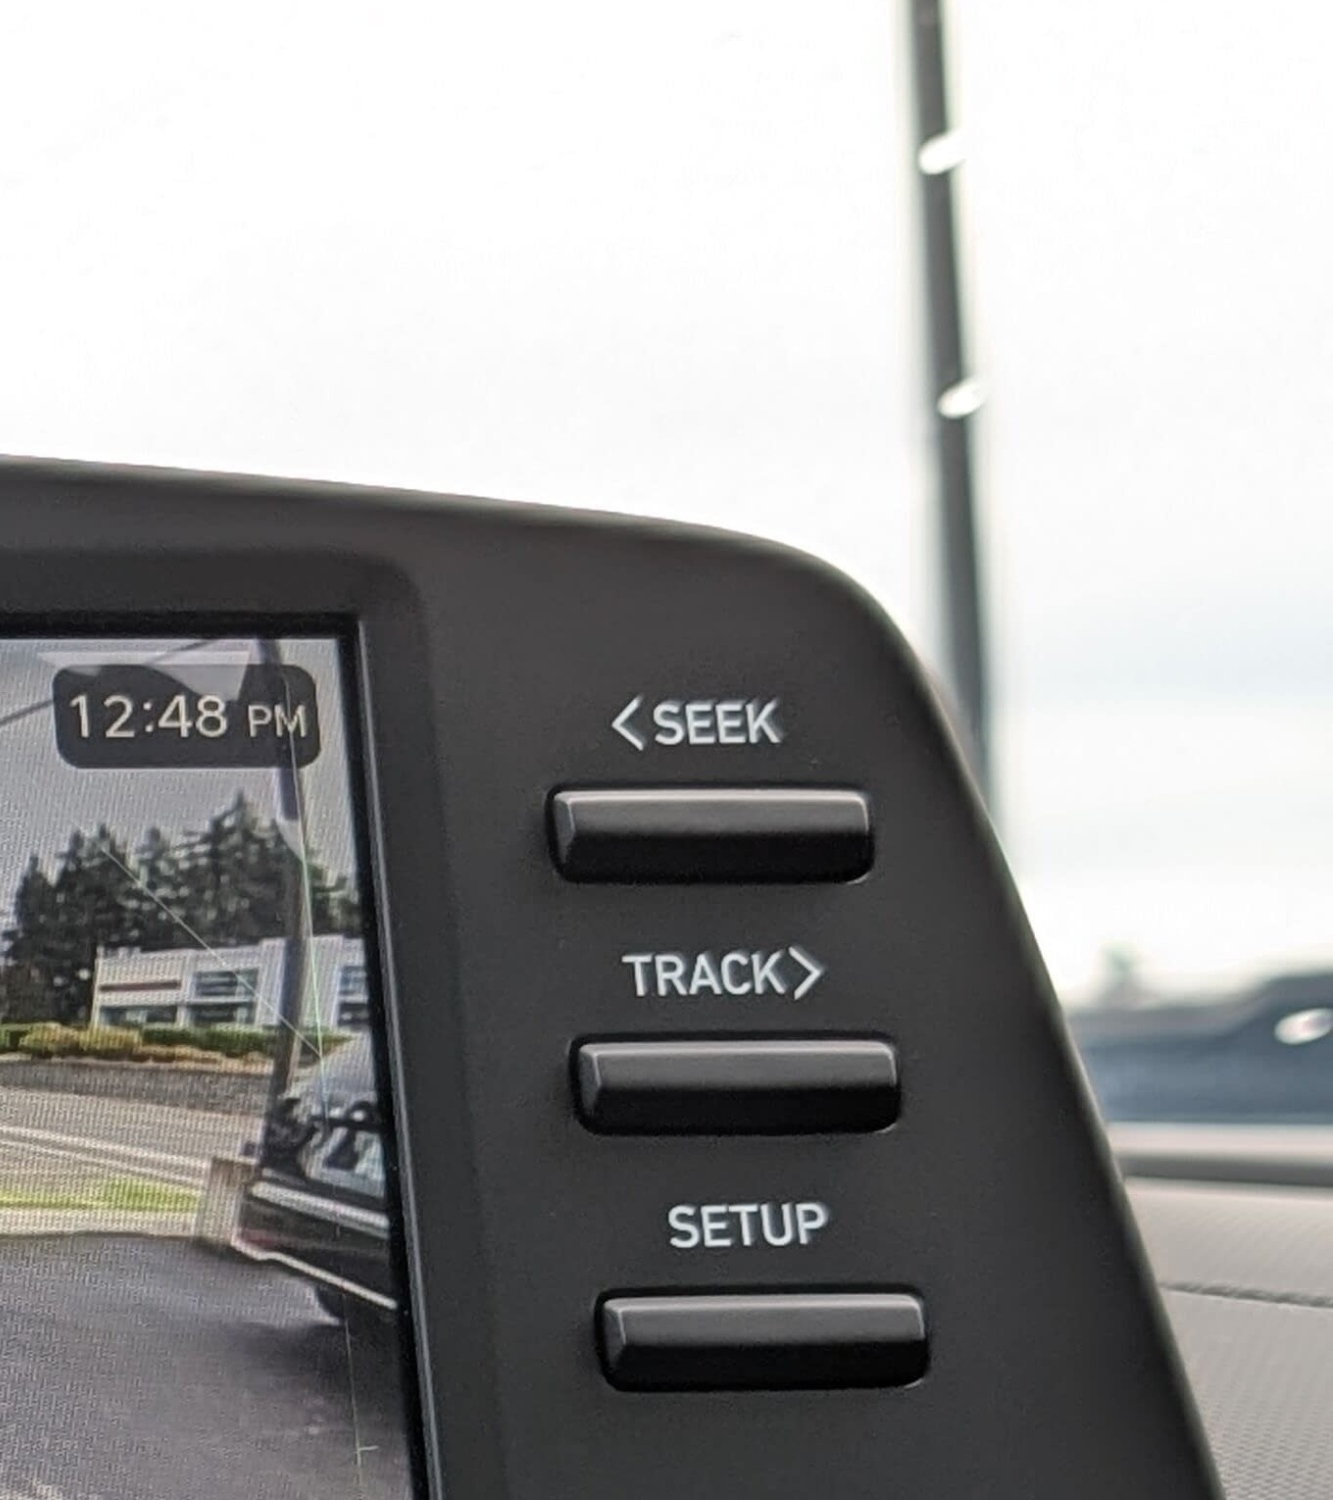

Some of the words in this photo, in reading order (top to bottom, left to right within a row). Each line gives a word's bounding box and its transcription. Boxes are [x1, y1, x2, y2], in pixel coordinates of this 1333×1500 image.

[69, 693, 229, 738] 12:48
[247, 704, 309, 738] PM
[653, 700, 782, 746] SEEK
[621, 952, 787, 998] TRACK
[667, 1203, 829, 1248] SETUP
